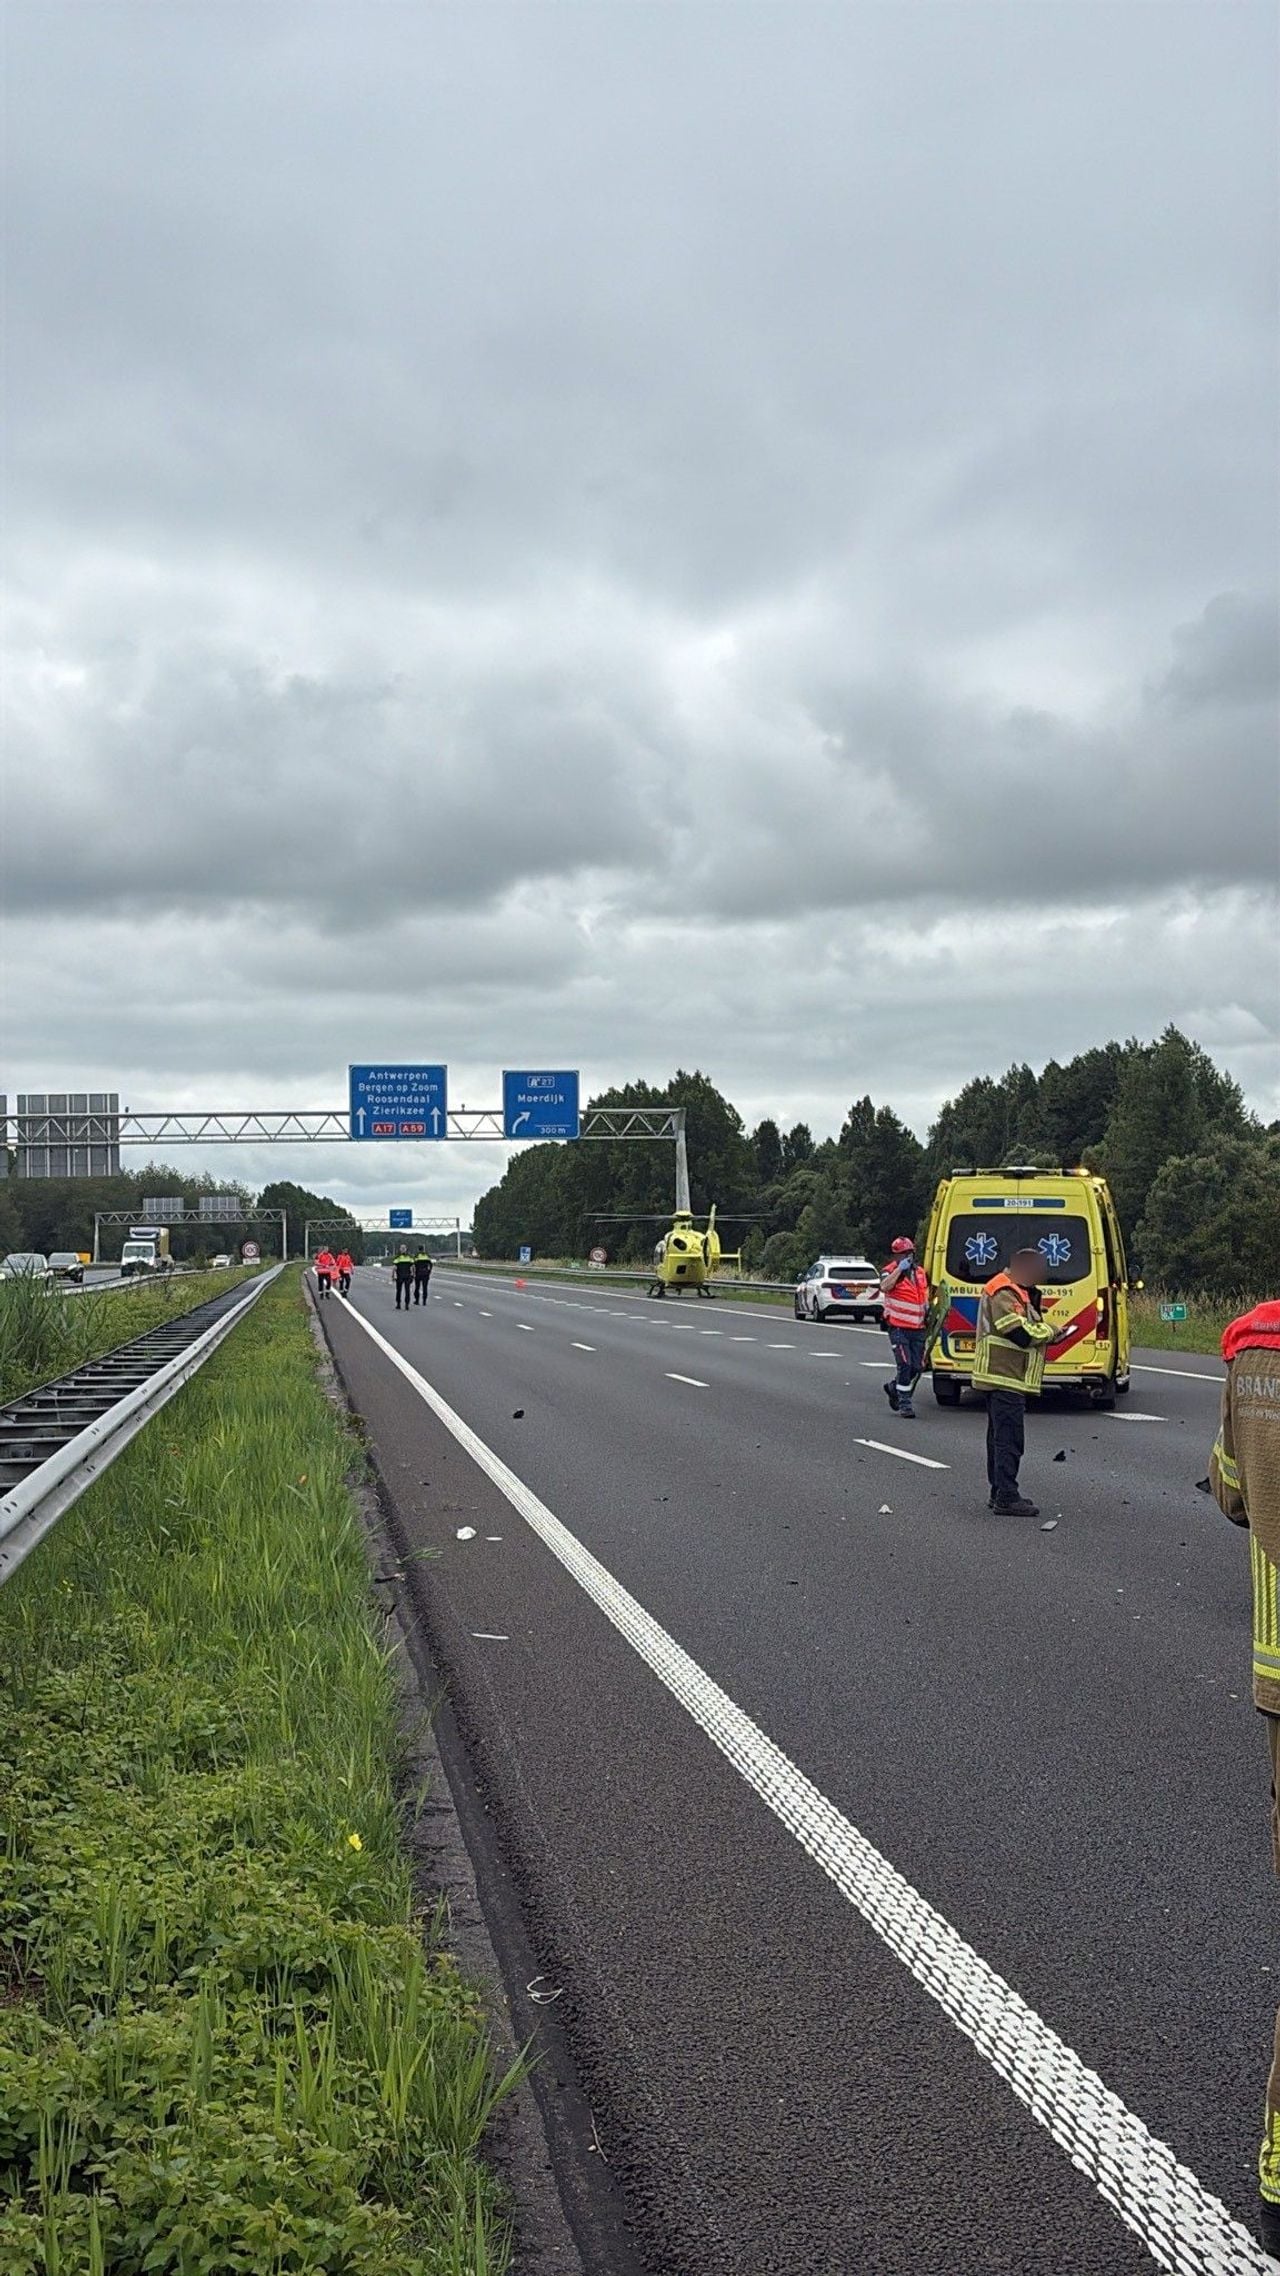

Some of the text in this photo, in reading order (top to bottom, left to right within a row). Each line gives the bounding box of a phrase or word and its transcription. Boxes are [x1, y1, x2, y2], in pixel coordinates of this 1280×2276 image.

[368, 1071, 428, 1081] Antwerpen
[358, 1083, 438, 1093] Bergen op Zoom
[367, 1094, 430, 1103] Roosendaal
[517, 1094, 565, 1105] Moerdijk
[372, 1106, 425, 1115] Zierikzee
[948, 1286, 985, 1295] MBUL
